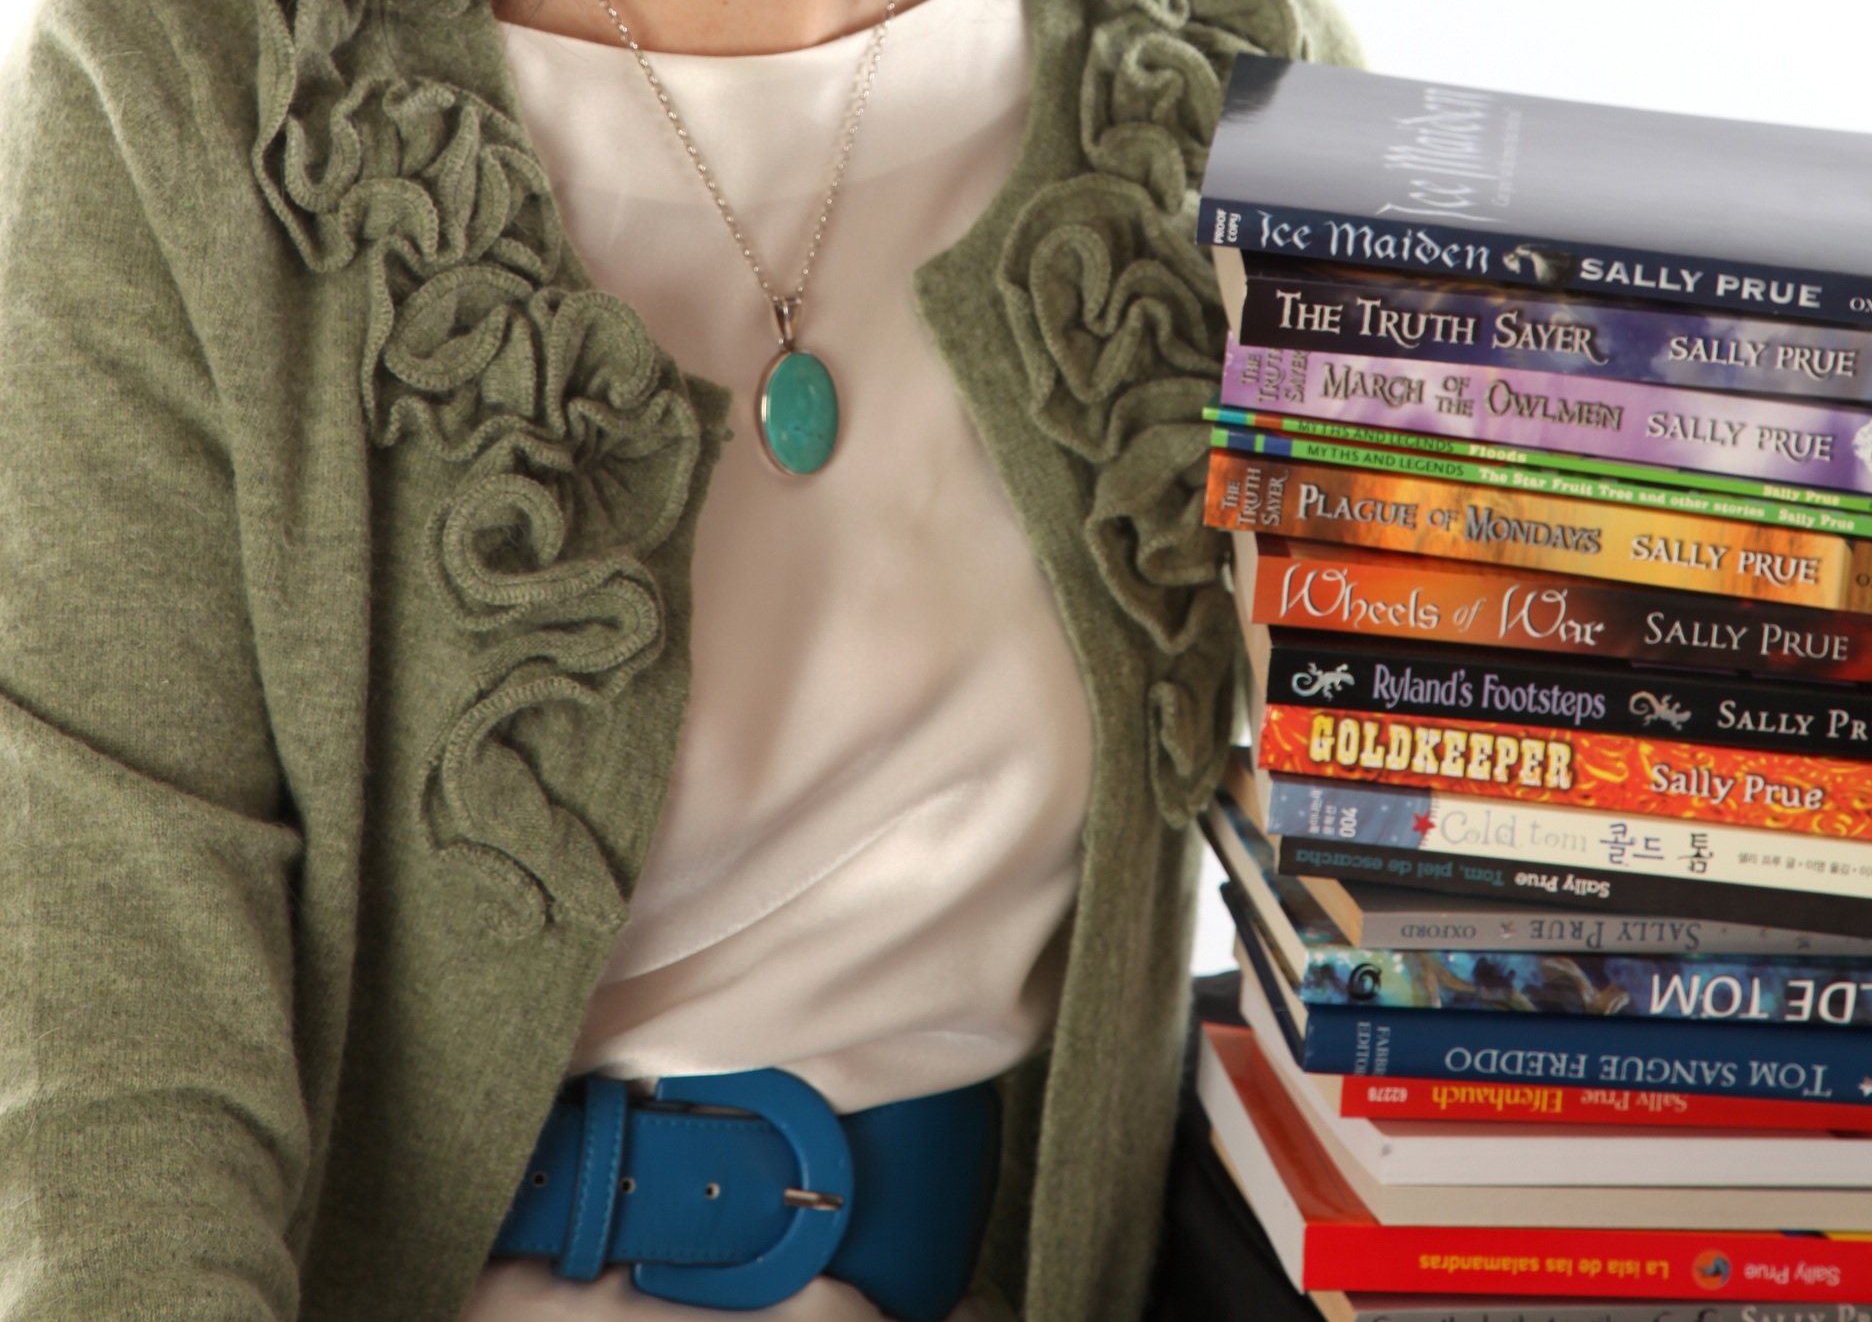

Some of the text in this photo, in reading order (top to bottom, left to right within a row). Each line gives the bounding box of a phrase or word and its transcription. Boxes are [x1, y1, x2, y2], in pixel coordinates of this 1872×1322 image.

[1212, 207, 1227, 245] PROOF
[1226, 212, 1241, 243] COPY
[1257, 210, 1311, 251] Ice
[1325, 220, 1490, 275] Maiden
[1580, 257, 1704, 293] SALLY
[1716, 274, 1823, 308] PRUE
[1276, 288, 1857, 382] THE TRUTH SAYER SALLY PRUE
[1241, 353, 1262, 385] THE
[1320, 362, 1835, 464] MARCH OF THE OWLMEN SALLY PRUE
[1307, 445, 1855, 531] MYTHS AND LEGENDS The Star Fruit Tree and other stories Sally Prue
[1354, 427, 1384, 444] AND
[1389, 432, 1454, 454] LEGENDS
[1468, 444, 1527, 463] Floods
[1763, 484, 1801, 502] Sally
[1805, 490, 1841, 506] Prue
[1221, 481, 1241, 510] THE
[1237, 468, 1262, 526] TRUTH
[1261, 470, 1289, 527] SAYER
[1296, 483, 1418, 528] PLAGUE
[1426, 509, 1458, 532] OF
[1463, 504, 1602, 555] MONDAYS
[1630, 534, 1728, 572] SALLY
[1737, 550, 1820, 589] PRUE
[1279, 563, 1849, 661] Wheels of War SALLY PRUE
[1372, 663, 1474, 709] Ryland's
[1481, 674, 1606, 725] Footsteps
[1717, 700, 1815, 736] SALLY
[1308, 714, 1824, 811] GOLDKEEPER Sally Prue
[1339, 806, 1359, 838] 004
[1440, 810, 1588, 854] Cold tom
[1599, 822, 1665, 868] 콜드
[1295, 849, 1611, 898] Sally Prue Tom, piel de escarcha
[1400, 918, 1702, 951] SALLY PRUE OXFORD
[1649, 973, 1858, 1025] DE TOM
[1444, 1046, 1832, 1099] TOM SANGUE FREDDO
[1367, 1085, 1688, 1114] Sally Prue Elfenhauch 62278
[1419, 1253, 1841, 1287] Sally Prue La isla de las salamandras
